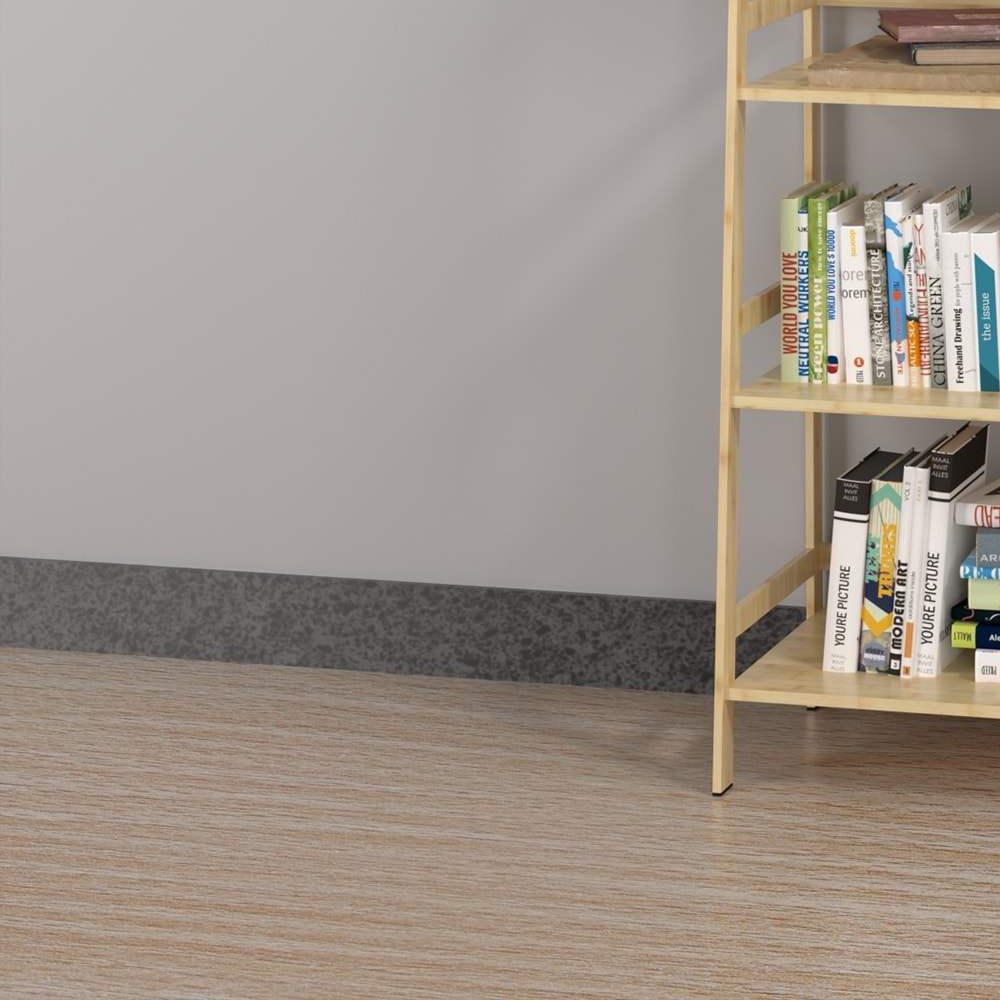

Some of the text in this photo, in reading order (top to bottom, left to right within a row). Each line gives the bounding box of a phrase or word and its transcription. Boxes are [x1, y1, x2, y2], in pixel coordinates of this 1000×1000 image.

[827, 230, 836, 251] 10000
[782, 252, 798, 354] WORLD YOU LOVE
[813, 276, 824, 329] power
[827, 279, 836, 294] YOU
[827, 296, 836, 320] WORLD
[798, 251, 809, 376] NEUTRAL WORKERS
[870, 249, 886, 378] STONE ARCHITECTURE
[929, 277, 946, 387] CHINA GREEN
[953, 308, 965, 343] Drawing
[981, 292, 991, 341] the issue
[907, 320, 917, 369] BALTIC SEA
[955, 345, 965, 384] Freehand
[896, 559, 909, 587] ART
[908, 570, 916, 589] inside
[834, 565, 851, 646] YOURE PICTURE
[891, 590, 907, 650] MODERN
[920, 551, 940, 645] YOURE PICTURE
